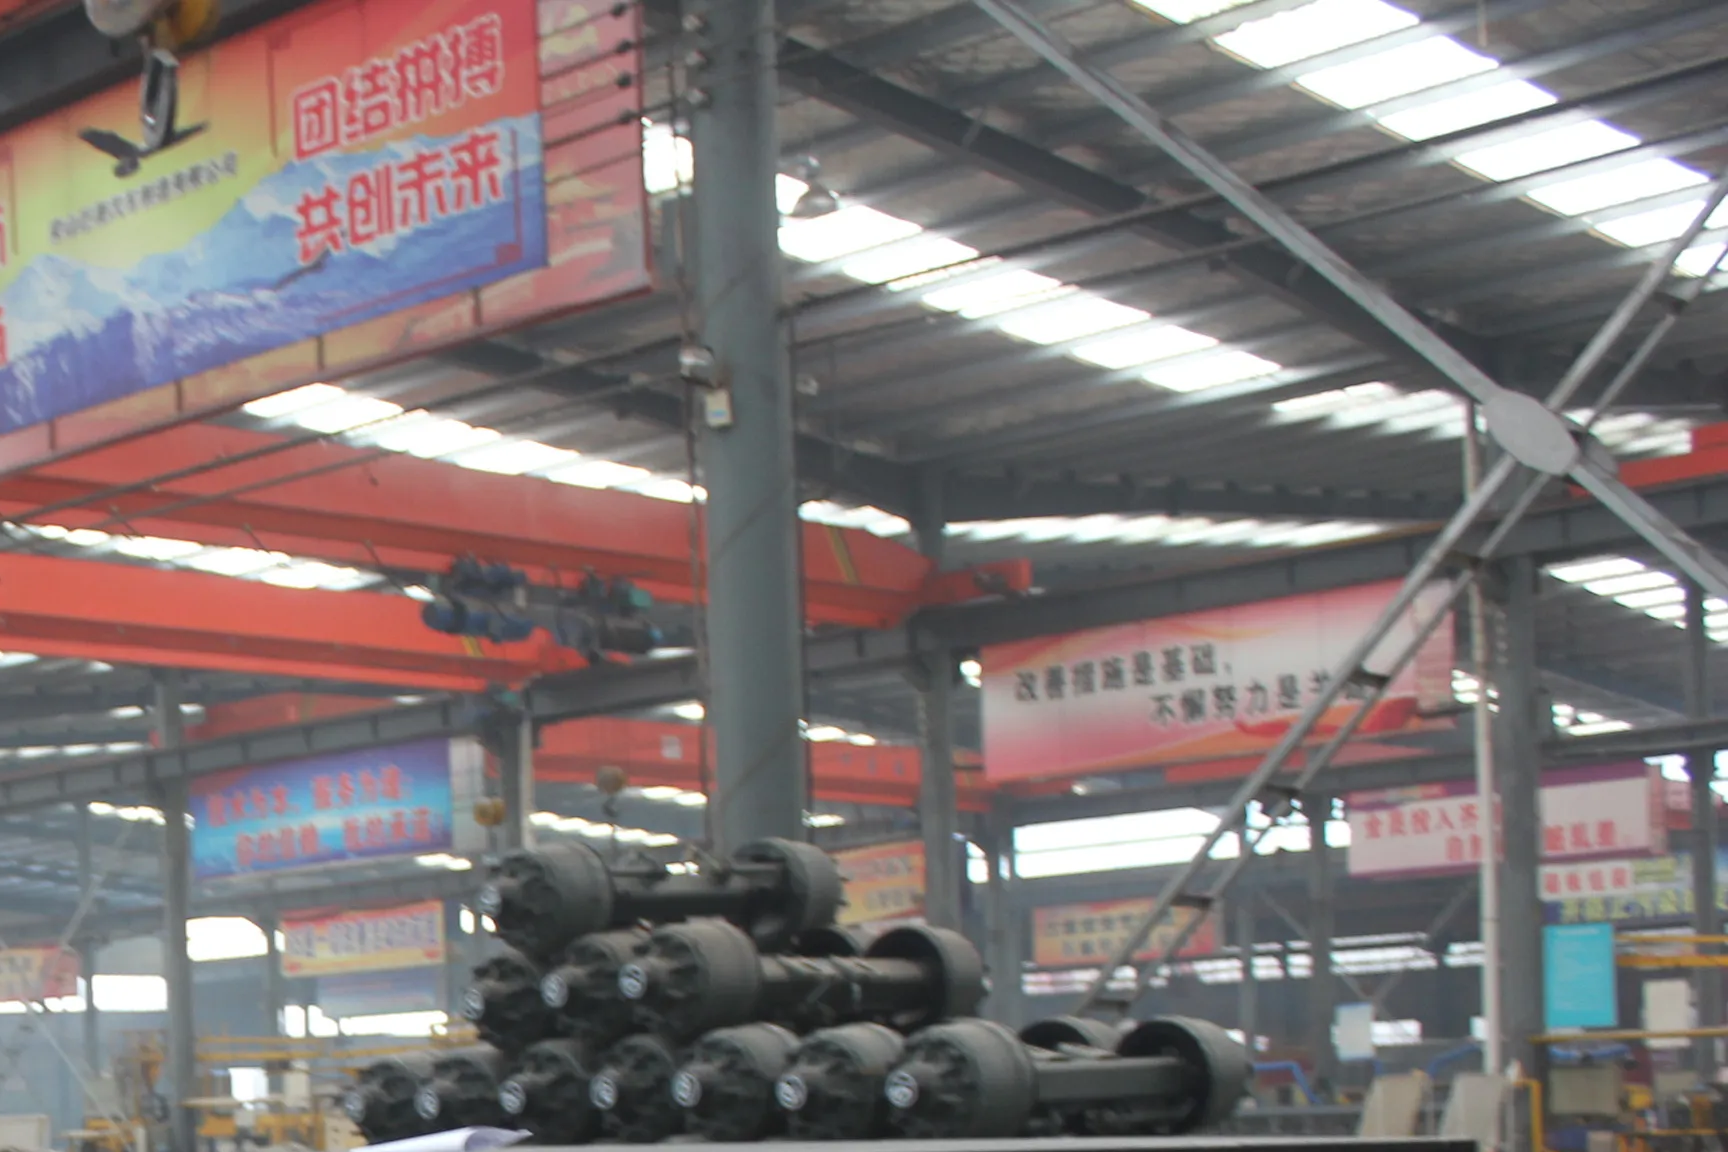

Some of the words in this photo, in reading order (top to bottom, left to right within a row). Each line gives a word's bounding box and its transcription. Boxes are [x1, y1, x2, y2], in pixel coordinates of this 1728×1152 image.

[291, 14, 506, 160] 团结拼搏
[294, 132, 506, 266] 共创未来
